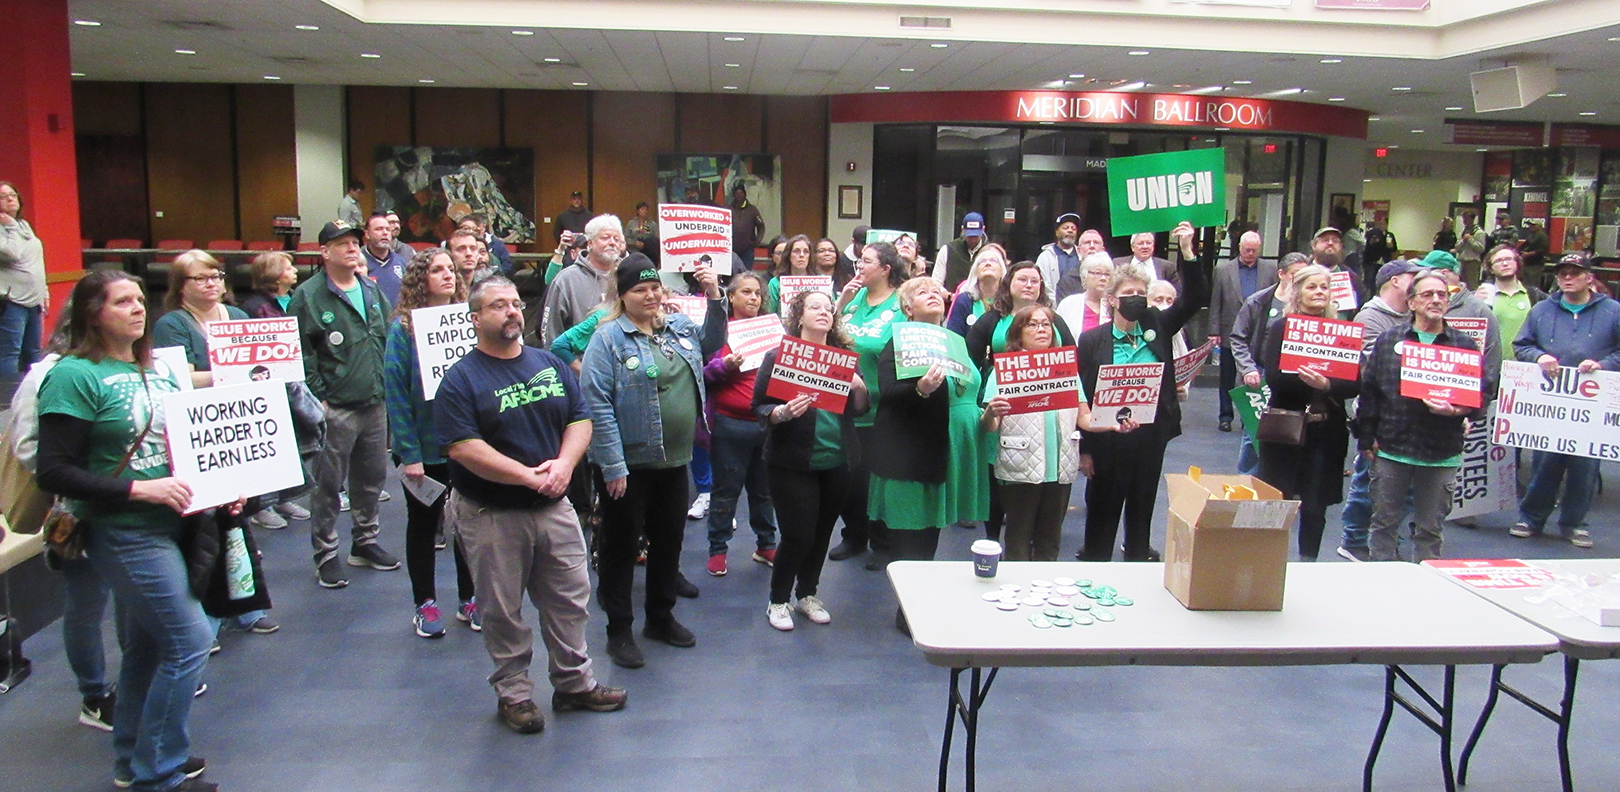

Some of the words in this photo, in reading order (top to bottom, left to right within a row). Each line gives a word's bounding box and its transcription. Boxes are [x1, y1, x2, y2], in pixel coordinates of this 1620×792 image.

[1016, 97, 1138, 120] MERIDIAN
[1153, 100, 1273, 126] BALLROOM
[1085, 160, 1107, 168] MAD
[1126, 171, 1213, 212] UNION
[661, 209, 724, 221] OVERWORKED
[675, 223, 725, 233] UNDERPAID
[665, 239, 729, 250] UNDERVALUED
[440, 311, 473, 327] AFSC
[210, 324, 243, 336] SIUE
[245, 321, 297, 334] WORKS
[737, 327, 778, 339] UNDERPAID
[845, 323, 882, 338] FSCME
[1287, 318, 1319, 332] THE
[1322, 322, 1363, 338] TIME
[231, 334, 278, 344] BECAUSE
[427, 327, 478, 346] EMPLO
[1288, 331, 1301, 340] IS
[1303, 333, 1336, 345] NOW
[216, 346, 252, 364] WE
[256, 344, 296, 361] DO!
[445, 345, 466, 360] DO
[782, 339, 815, 359] THE
[819, 349, 858, 369] TIME
[901, 350, 928, 359] FAIR
[1283, 344, 1304, 352] FAIR
[1306, 347, 1359, 360] CONTRACT!
[1403, 344, 1436, 360] THE
[1439, 349, 1480, 367] TIME
[780, 353, 794, 366] IS
[796, 358, 830, 374] NOW
[995, 355, 1030, 371] THE
[1033, 350, 1075, 367] TIME
[1405, 357, 1418, 367] IS
[1421, 360, 1455, 373] NOW
[432, 364, 449, 379] RE
[1000, 371, 1014, 382] IS
[1016, 367, 1051, 381] NOW
[1100, 367, 1124, 378] SIUE
[1125, 366, 1162, 377] WORKS
[1402, 370, 1423, 380] FAIR
[1425, 374, 1479, 388] CONTRACT!
[773, 368, 796, 379] FAIR
[797, 374, 849, 393] CONTRACT!
[998, 386, 1021, 395] FAIR
[1022, 379, 1077, 393] CONTRACT!
[1111, 378, 1146, 387] BECAUSE
[494, 385, 513, 397] Local
[499, 383, 566, 413] AFSCME
[1098, 389, 1123, 404] WE
[1124, 388, 1155, 402] DO!
[187, 396, 268, 425] WORKING
[1498, 388, 1567, 421] WORKING
[1571, 408, 1591, 423] US
[190, 422, 253, 450] HARDER
[255, 418, 278, 438] TO
[1494, 418, 1550, 450] PAYING
[1557, 438, 1577, 453] US
[197, 447, 242, 473] EARN
[244, 440, 276, 463] LESS
[1463, 416, 1488, 500] RUSTEES
